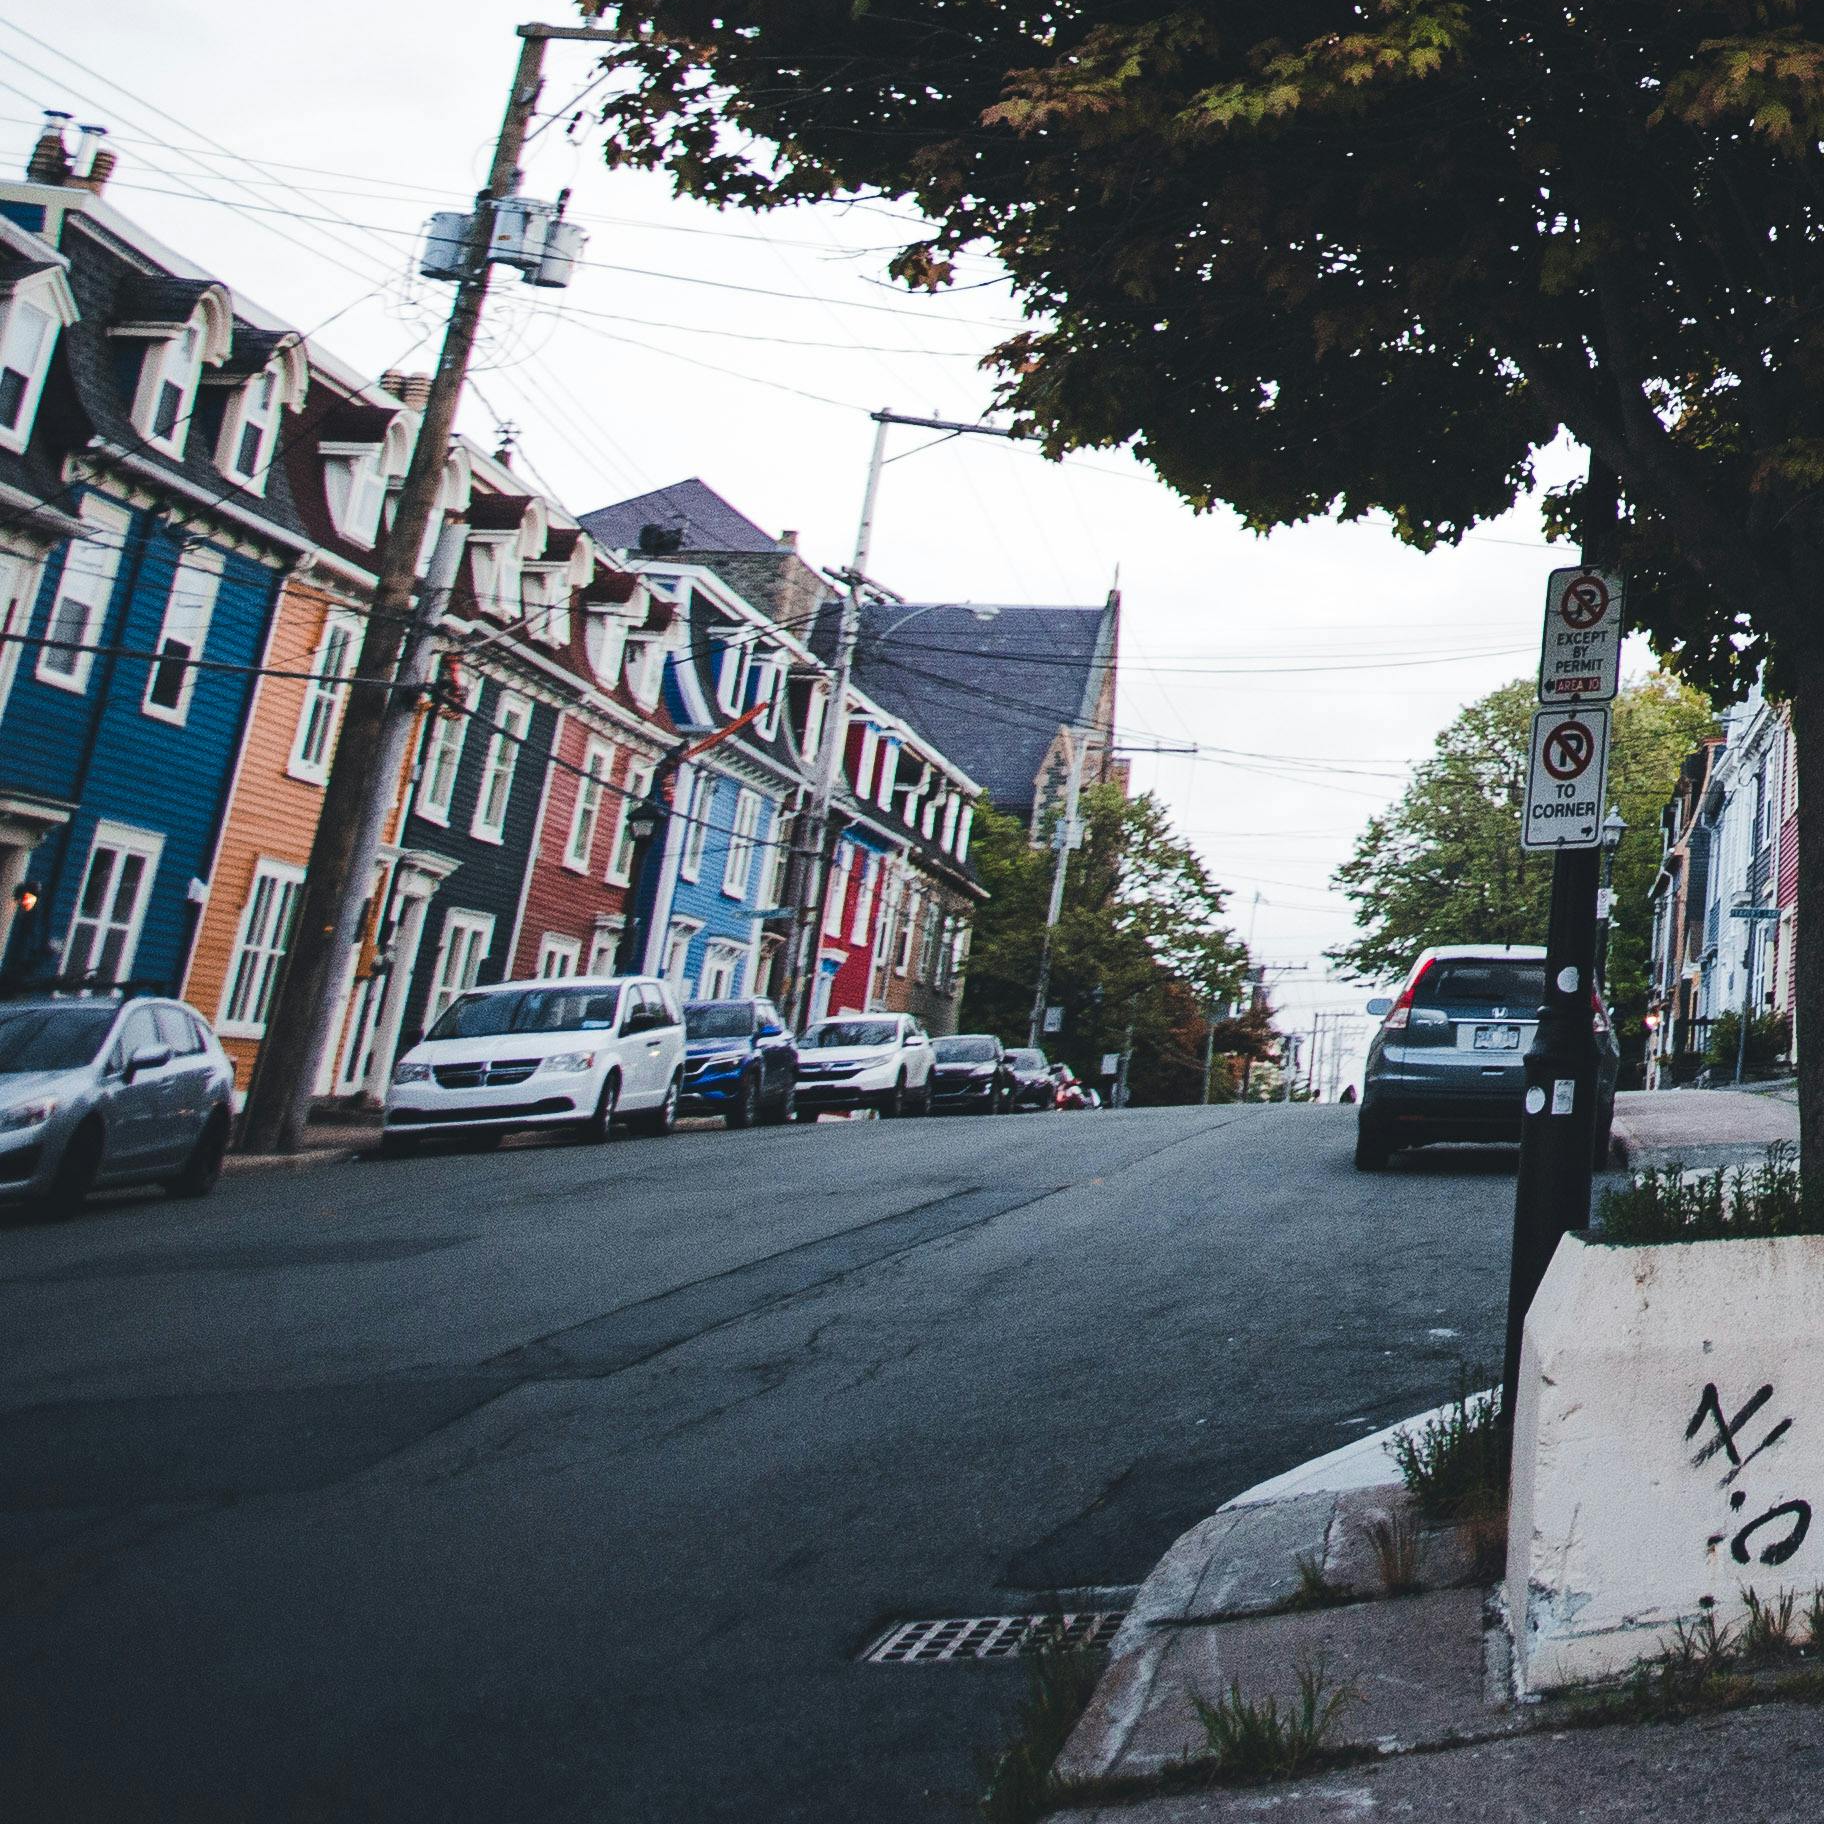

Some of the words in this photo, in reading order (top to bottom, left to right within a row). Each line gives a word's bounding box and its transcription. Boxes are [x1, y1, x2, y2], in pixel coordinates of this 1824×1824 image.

[1557, 630, 1608, 646] EXCEPT
[1572, 645, 1589, 658] BY
[1556, 658, 1604, 674] PERMIT
[1557, 679, 1584, 691] AREA
[1555, 783, 1576, 799] TO
[1532, 801, 1596, 819] CORNER
